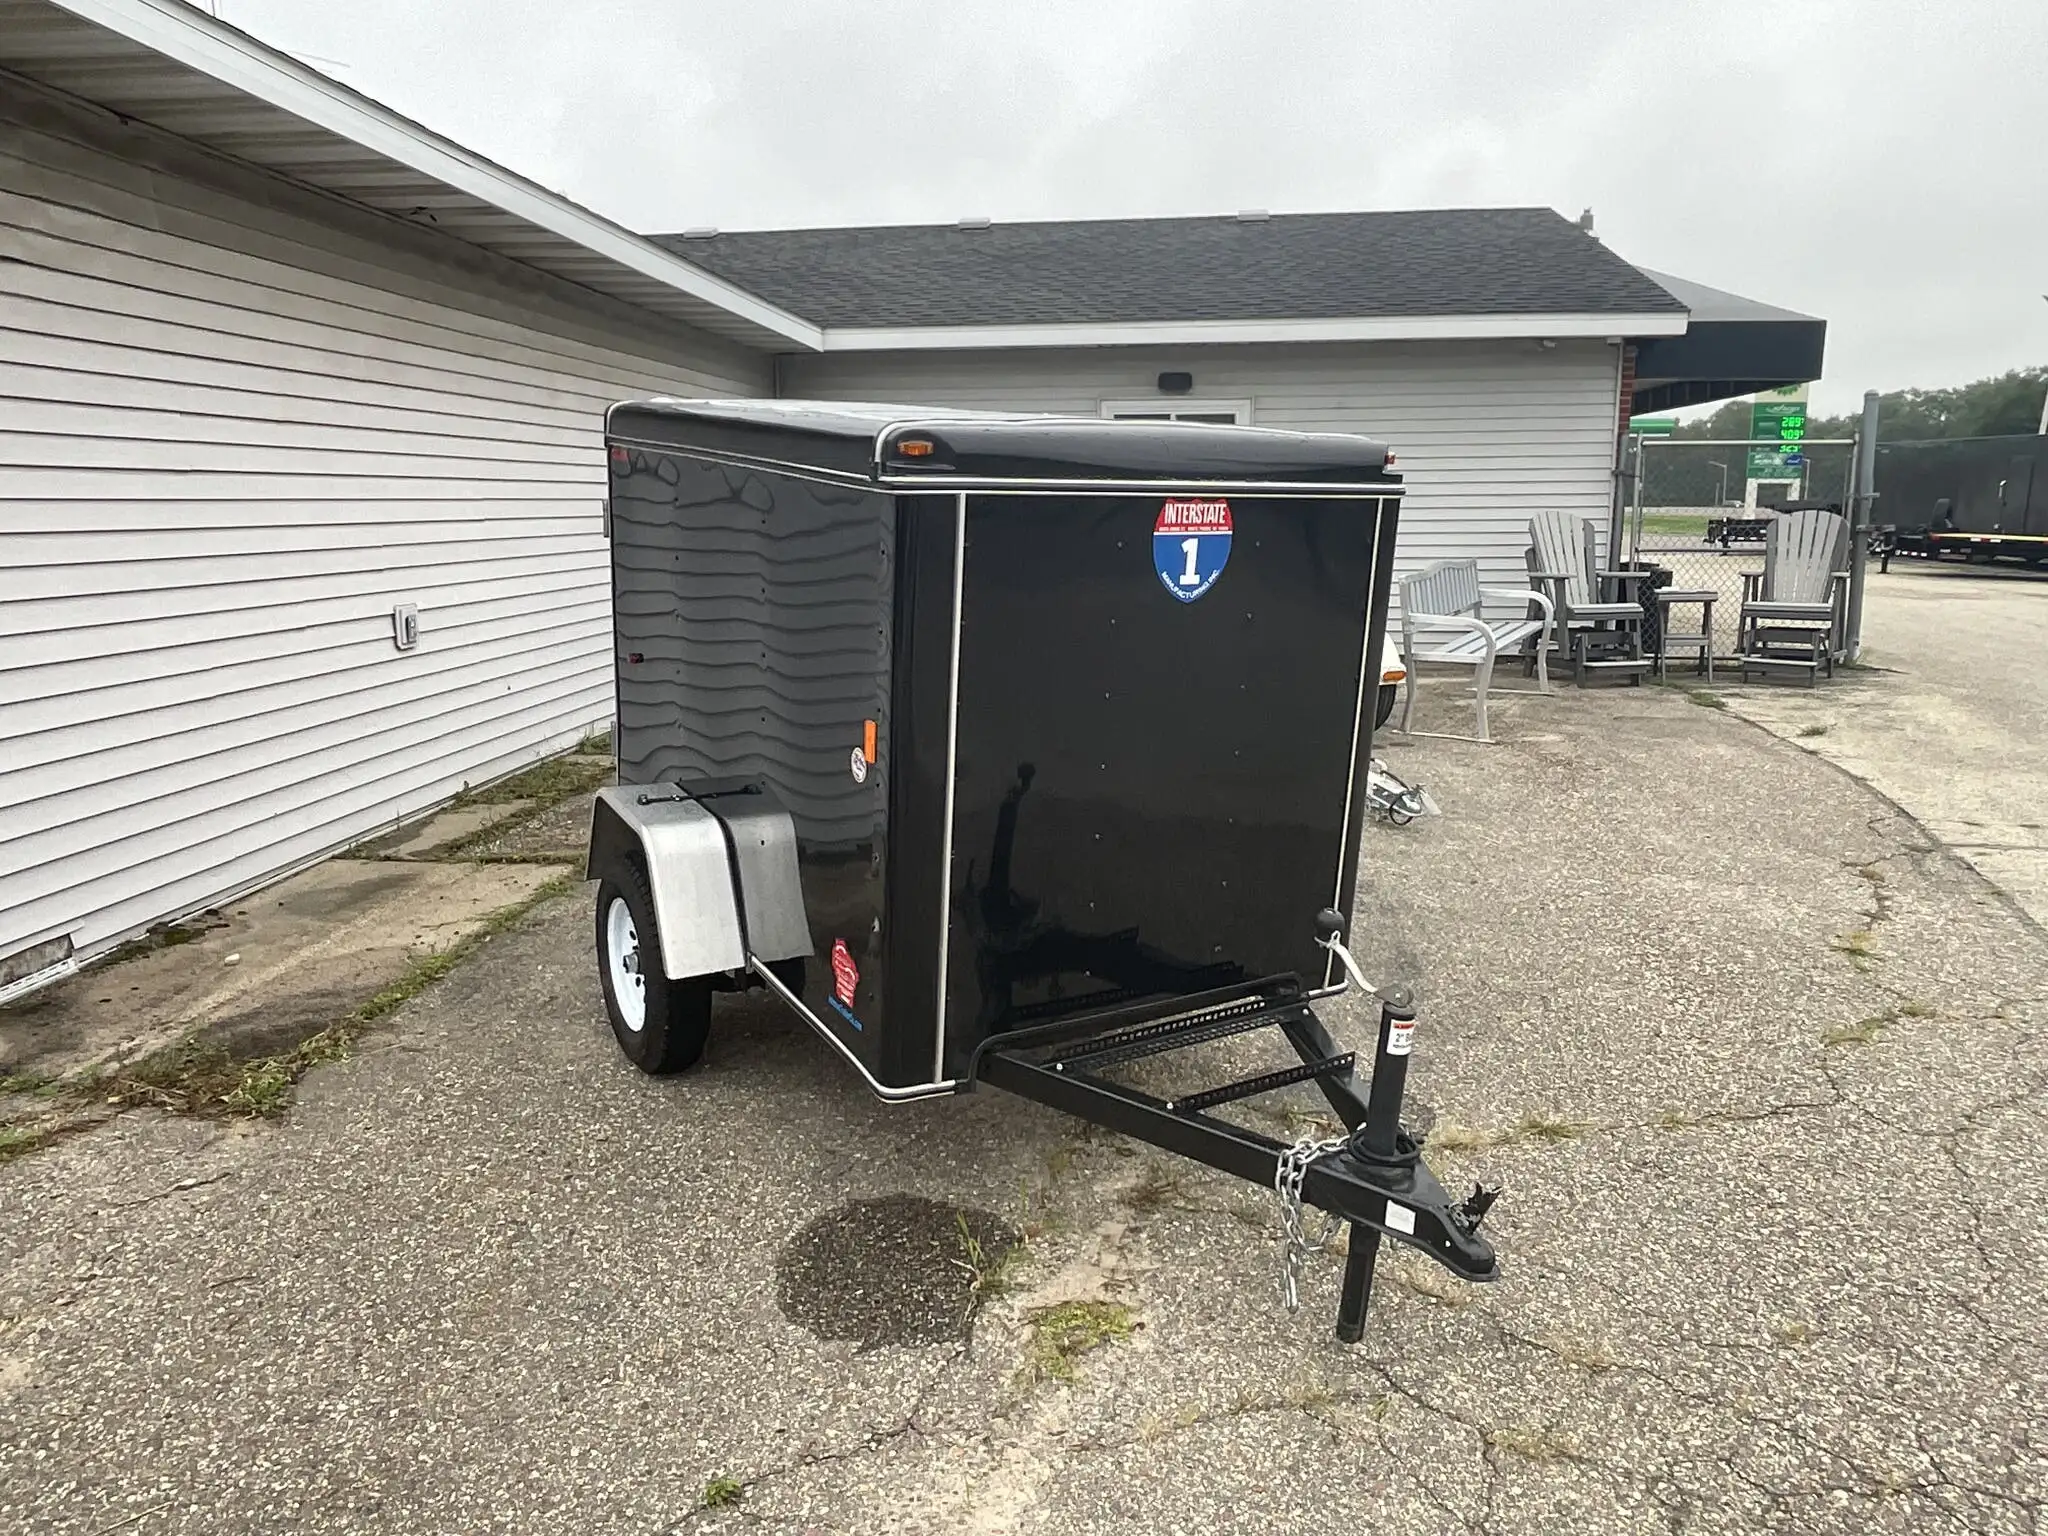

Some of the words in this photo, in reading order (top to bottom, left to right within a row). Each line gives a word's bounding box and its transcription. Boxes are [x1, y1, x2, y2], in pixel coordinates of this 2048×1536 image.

[1164, 503, 1227, 524] INTERSTATE
[1179, 537, 1201, 586] 1
[1161, 570, 1210, 599] MANUFACTURING
